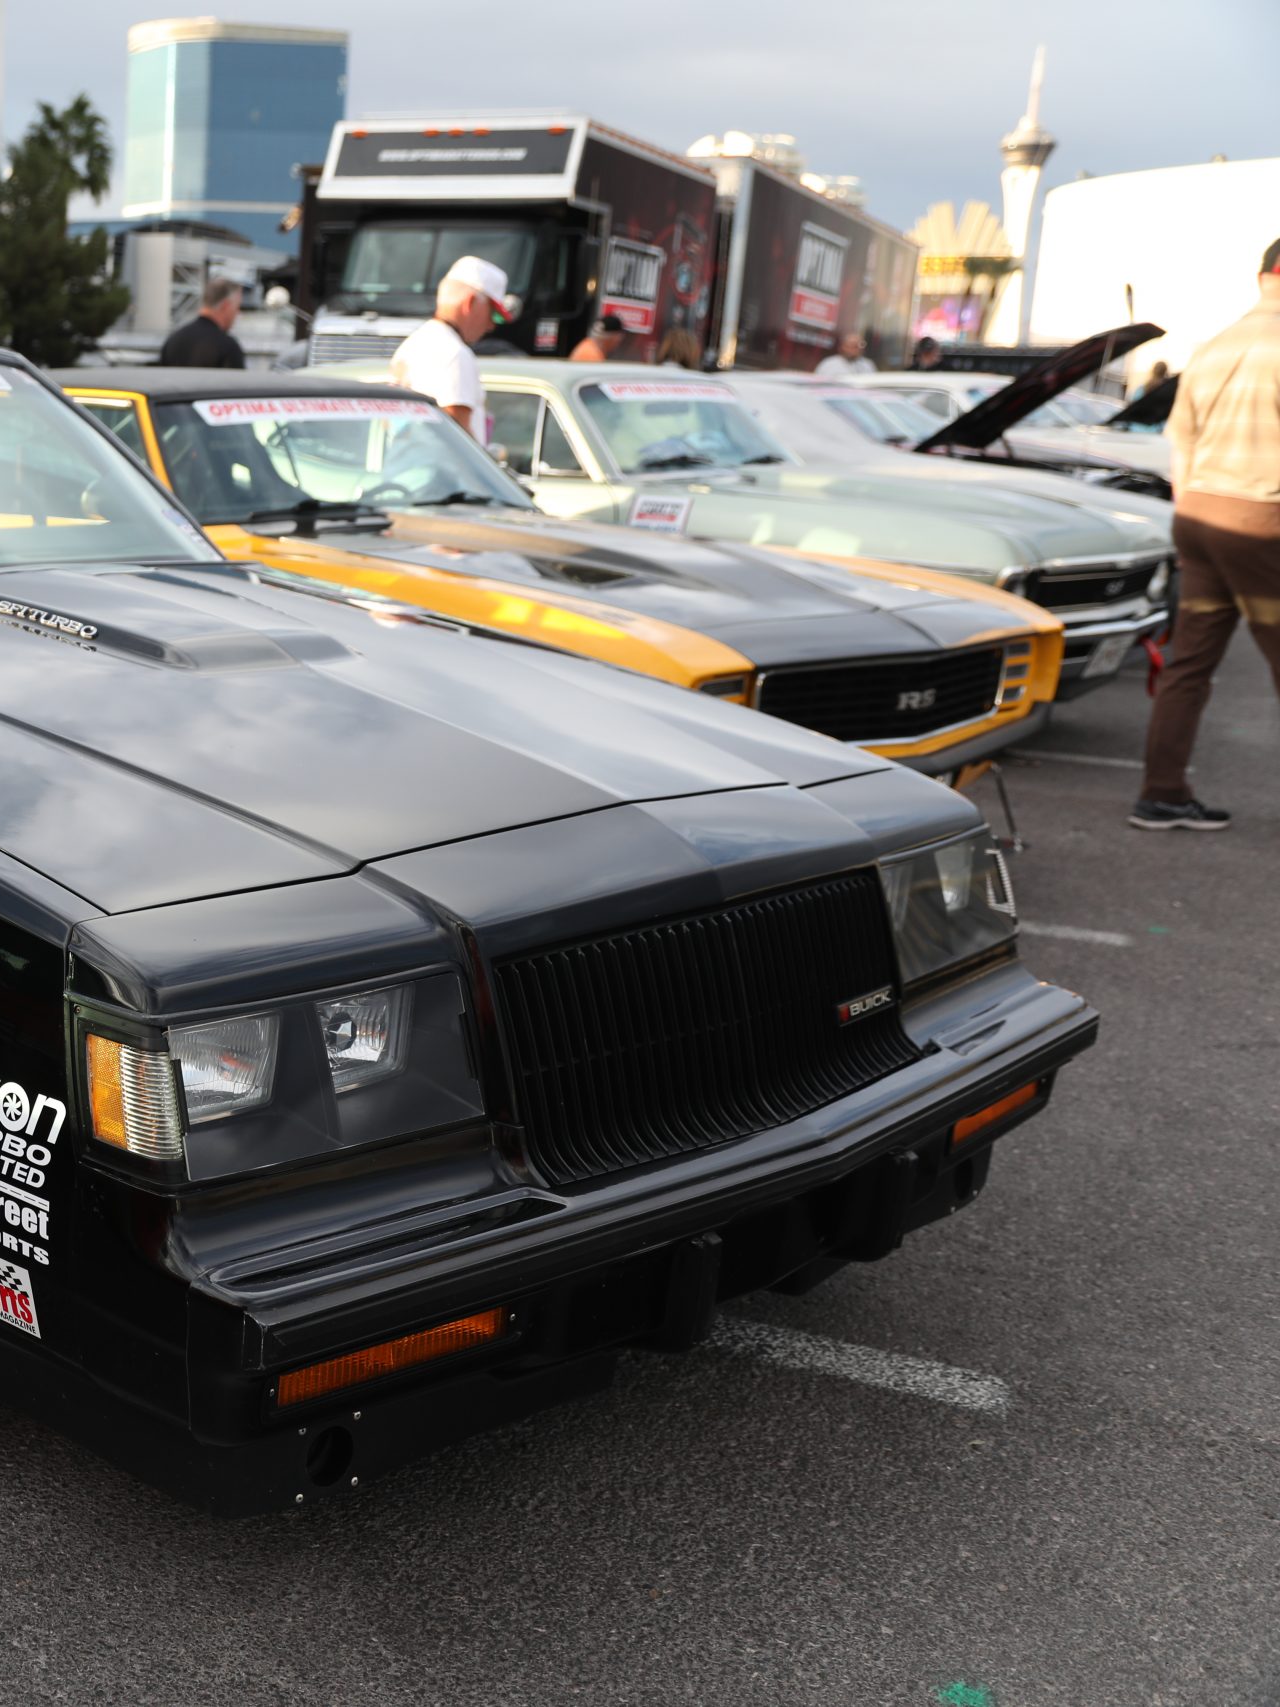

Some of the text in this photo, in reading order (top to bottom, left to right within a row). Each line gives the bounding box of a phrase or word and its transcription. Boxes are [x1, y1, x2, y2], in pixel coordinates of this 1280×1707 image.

[208, 402, 279, 418] OPTIMA
[28, 609, 98, 639] TURBO
[896, 688, 937, 711] RS
[849, 990, 891, 1016] BUICK
